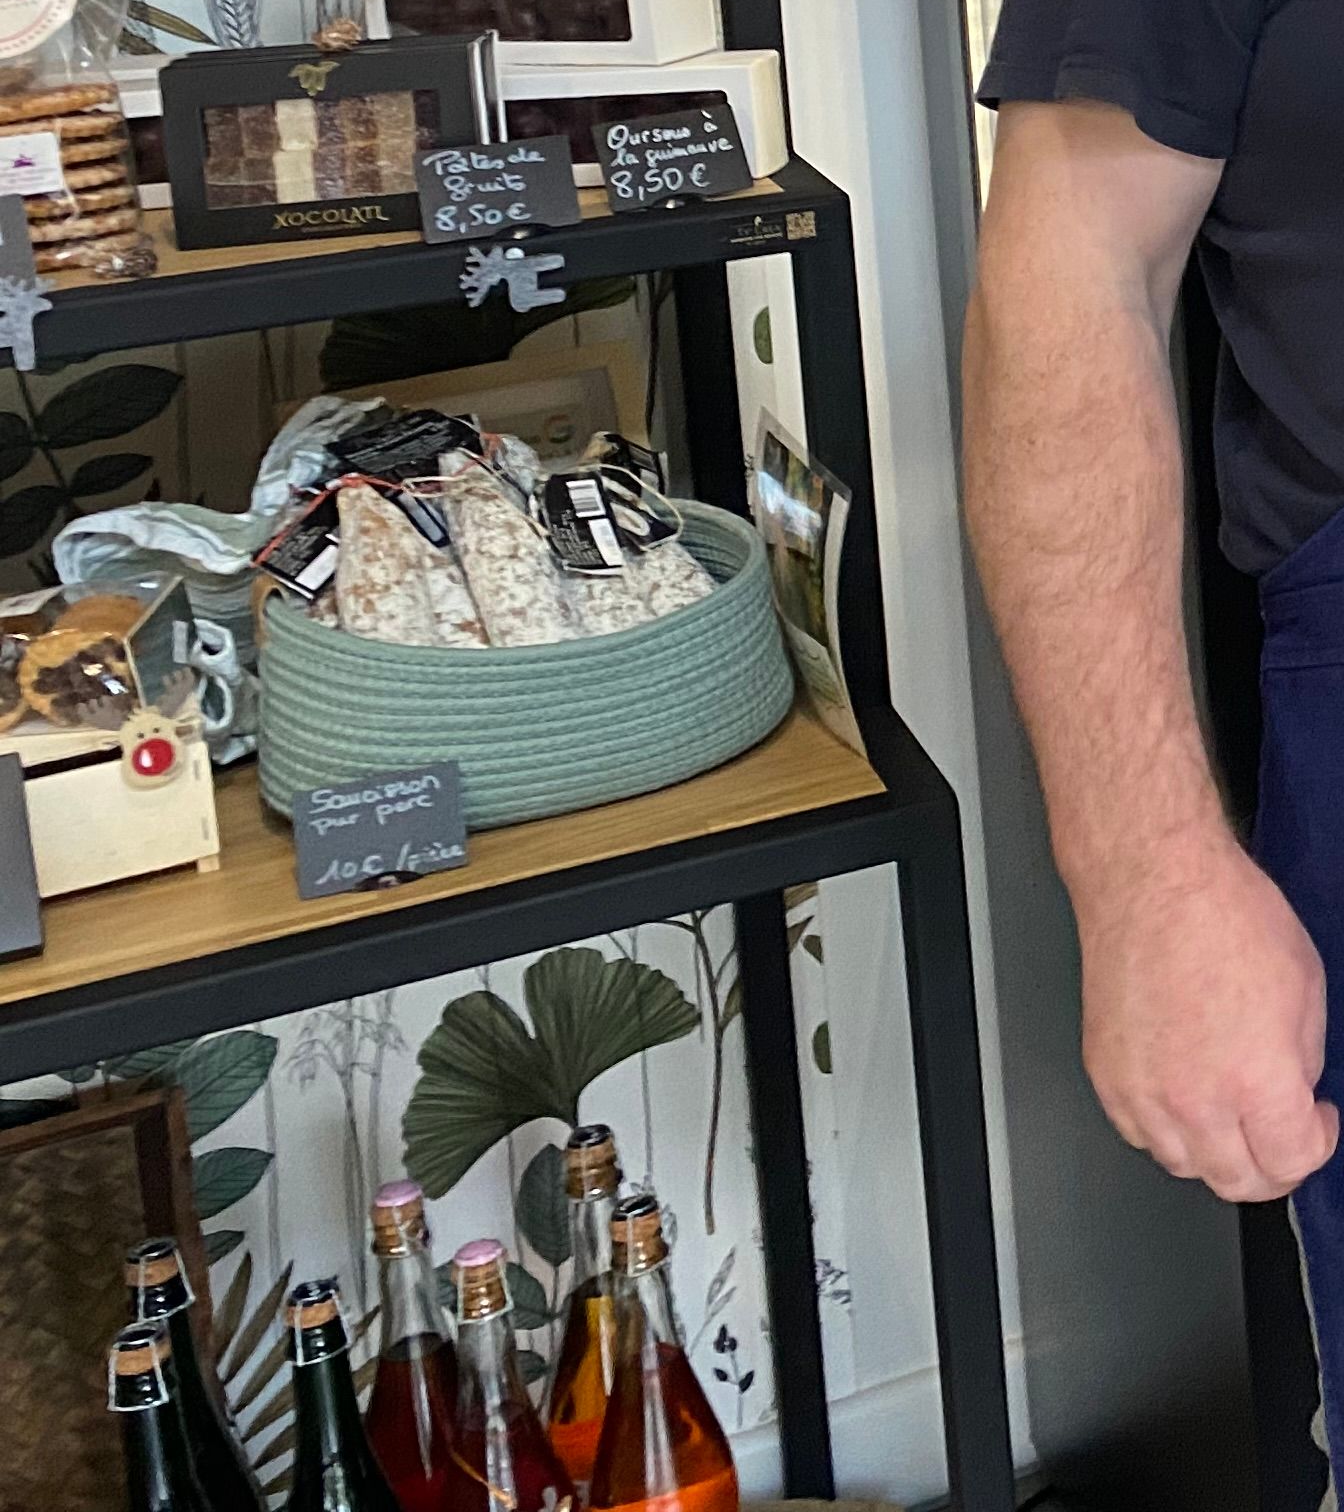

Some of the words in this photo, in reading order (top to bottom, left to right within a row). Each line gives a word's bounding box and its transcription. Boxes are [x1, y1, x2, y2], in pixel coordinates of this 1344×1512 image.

[506, 147, 546, 164] de
[443, 171, 527, 202] fruits
[309, 813, 361, 836] pur
